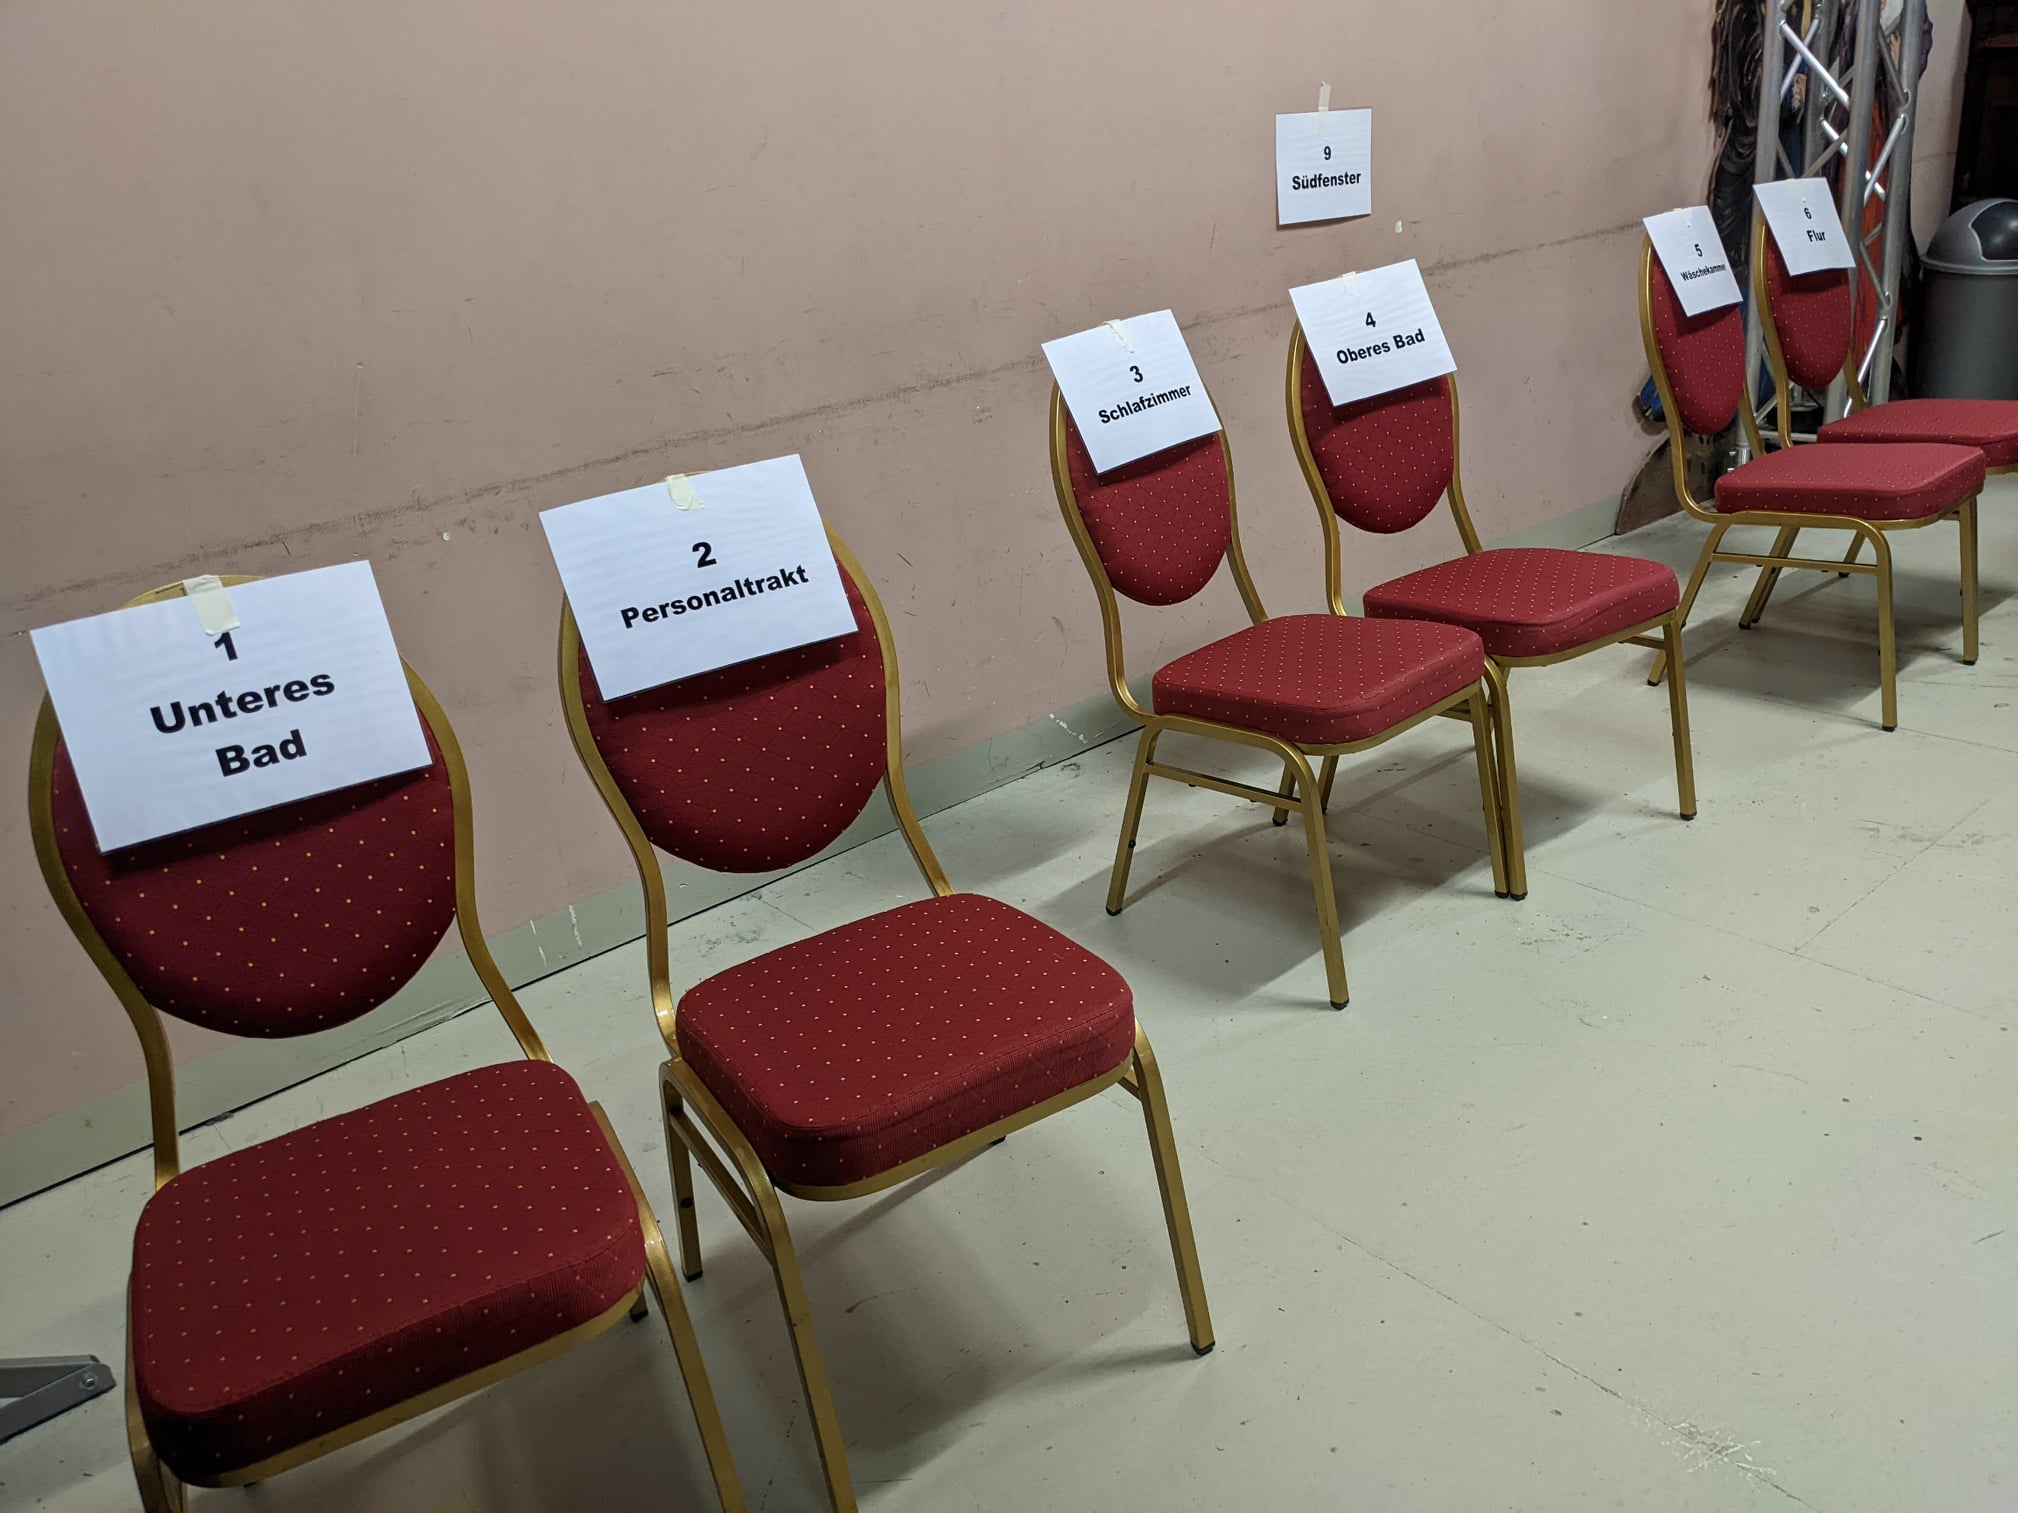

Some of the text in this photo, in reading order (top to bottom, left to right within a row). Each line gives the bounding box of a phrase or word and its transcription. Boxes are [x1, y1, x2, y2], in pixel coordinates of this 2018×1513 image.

[1322, 144, 1332, 161] 9
[1291, 170, 1362, 191] Südfenster
[1803, 207, 1812, 220] 6
[1806, 229, 1826, 243] Flur
[1694, 243, 1703, 257] 5
[1680, 262, 1727, 282] Wäschekammer
[1364, 311, 1377, 329] 4
[1336, 328, 1426, 366] Oberes Bad
[1129, 365, 1144, 383] 3
[1097, 384, 1192, 425] Schlafzimmer
[691, 541, 718, 569] 2
[620, 562, 809, 630] Personaltrakt
[213, 630, 238, 661] 1
[149, 674, 335, 736] Unteres
[215, 728, 308, 778] Bad
